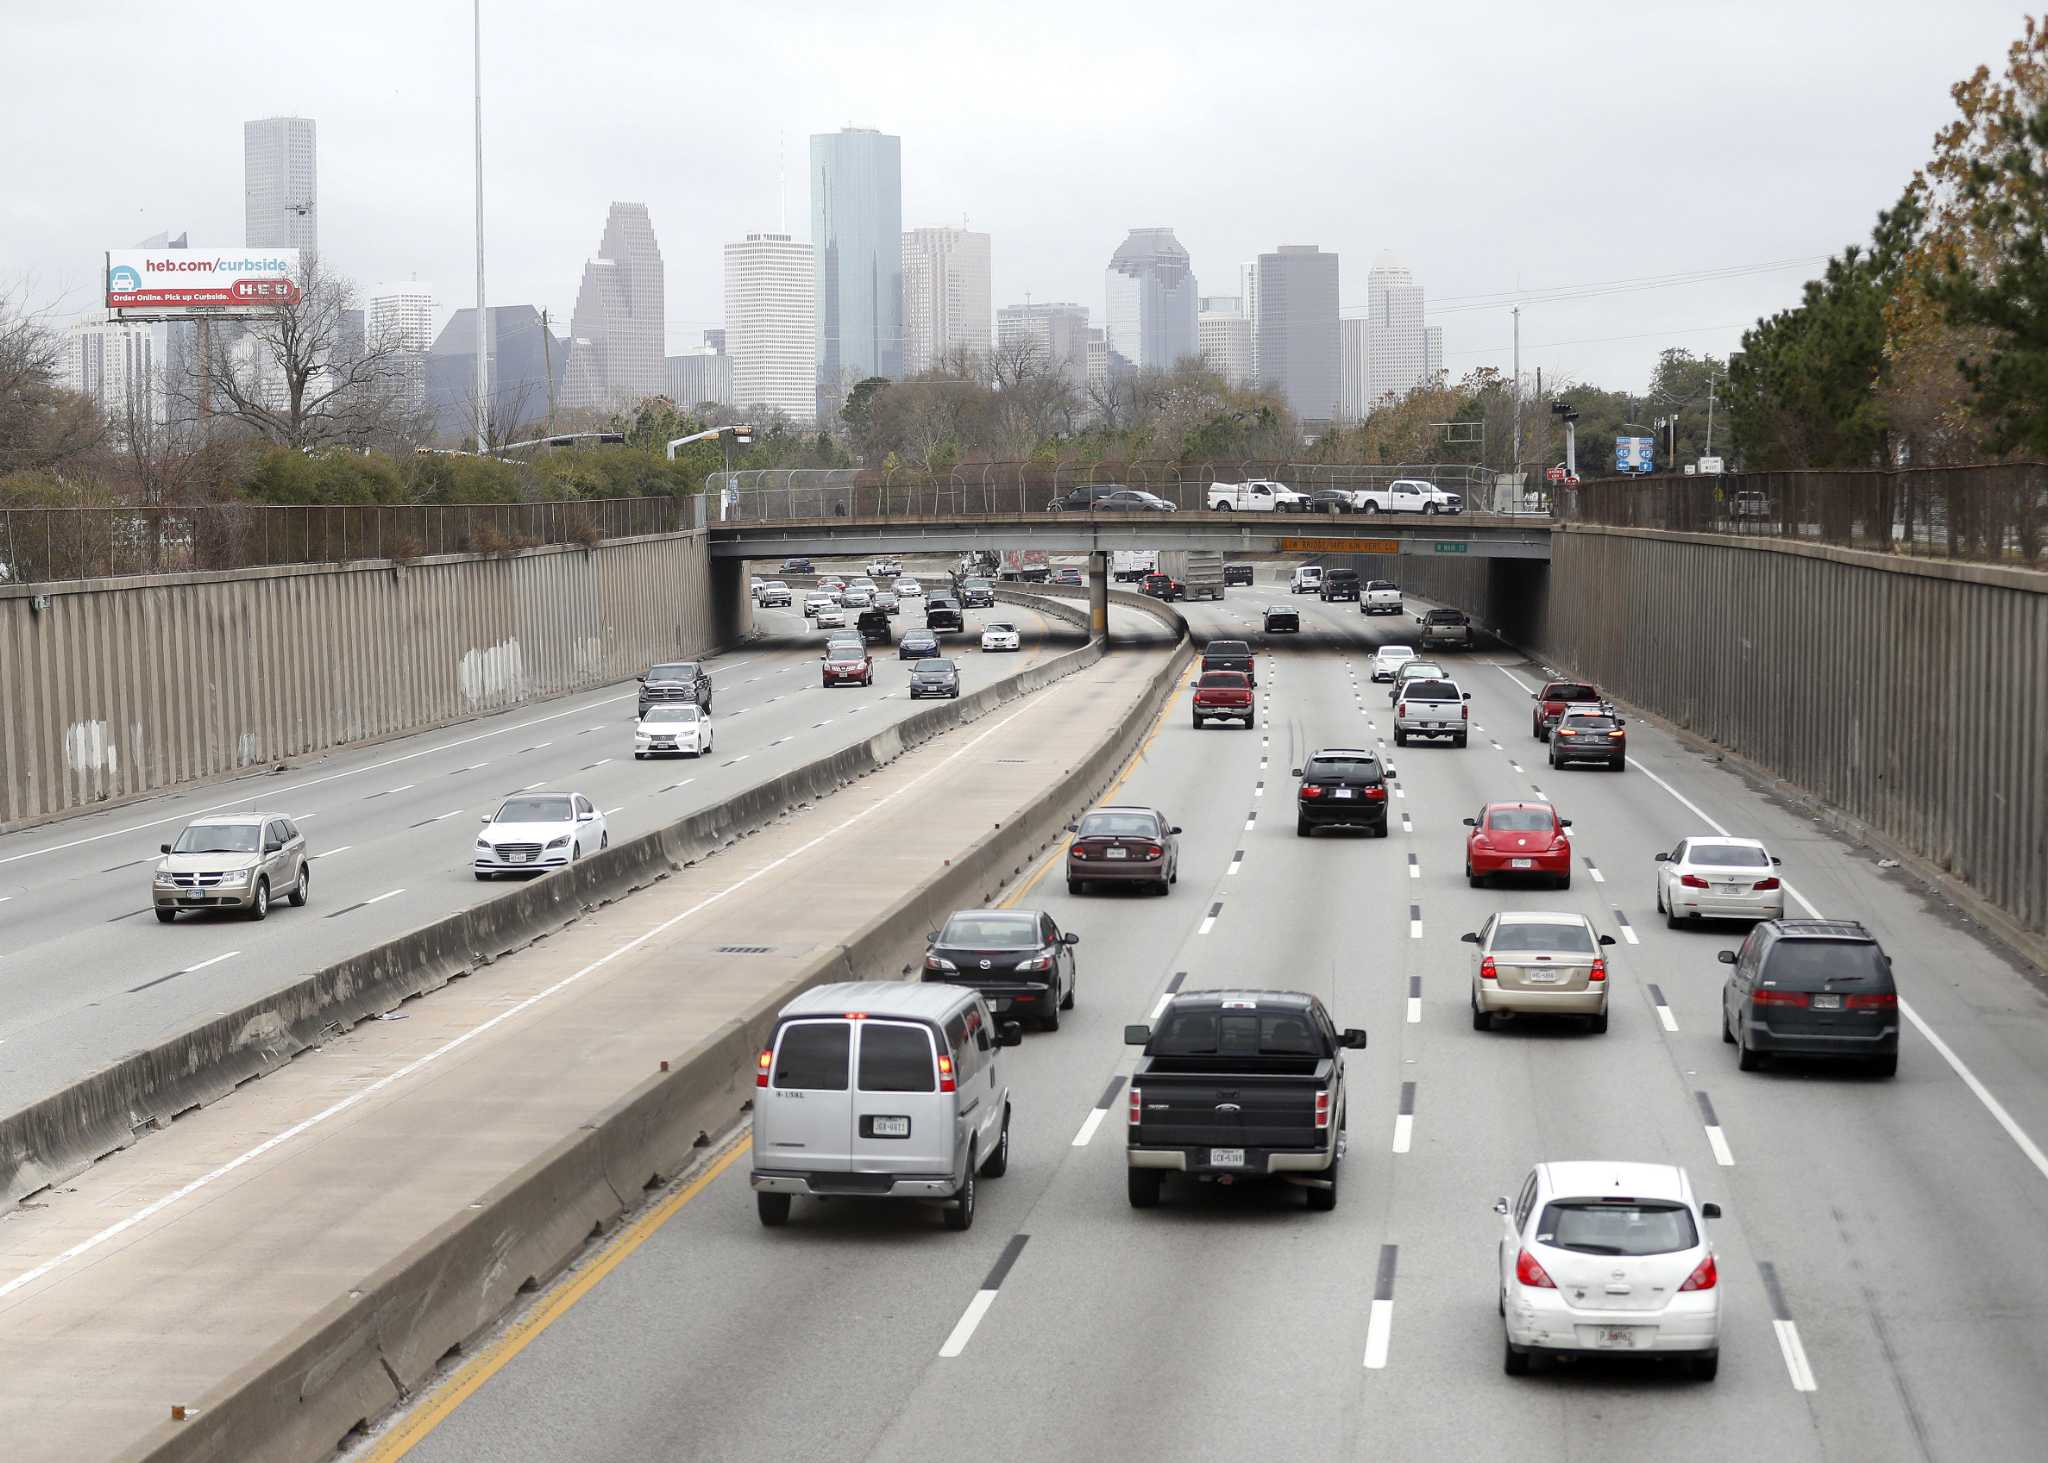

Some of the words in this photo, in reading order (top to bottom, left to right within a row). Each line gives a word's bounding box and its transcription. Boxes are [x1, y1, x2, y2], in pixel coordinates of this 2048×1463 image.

[146, 258, 287, 273] heb.com/curbside
[165, 293, 181, 301] Pick
[194, 293, 229, 301] Curbside.
